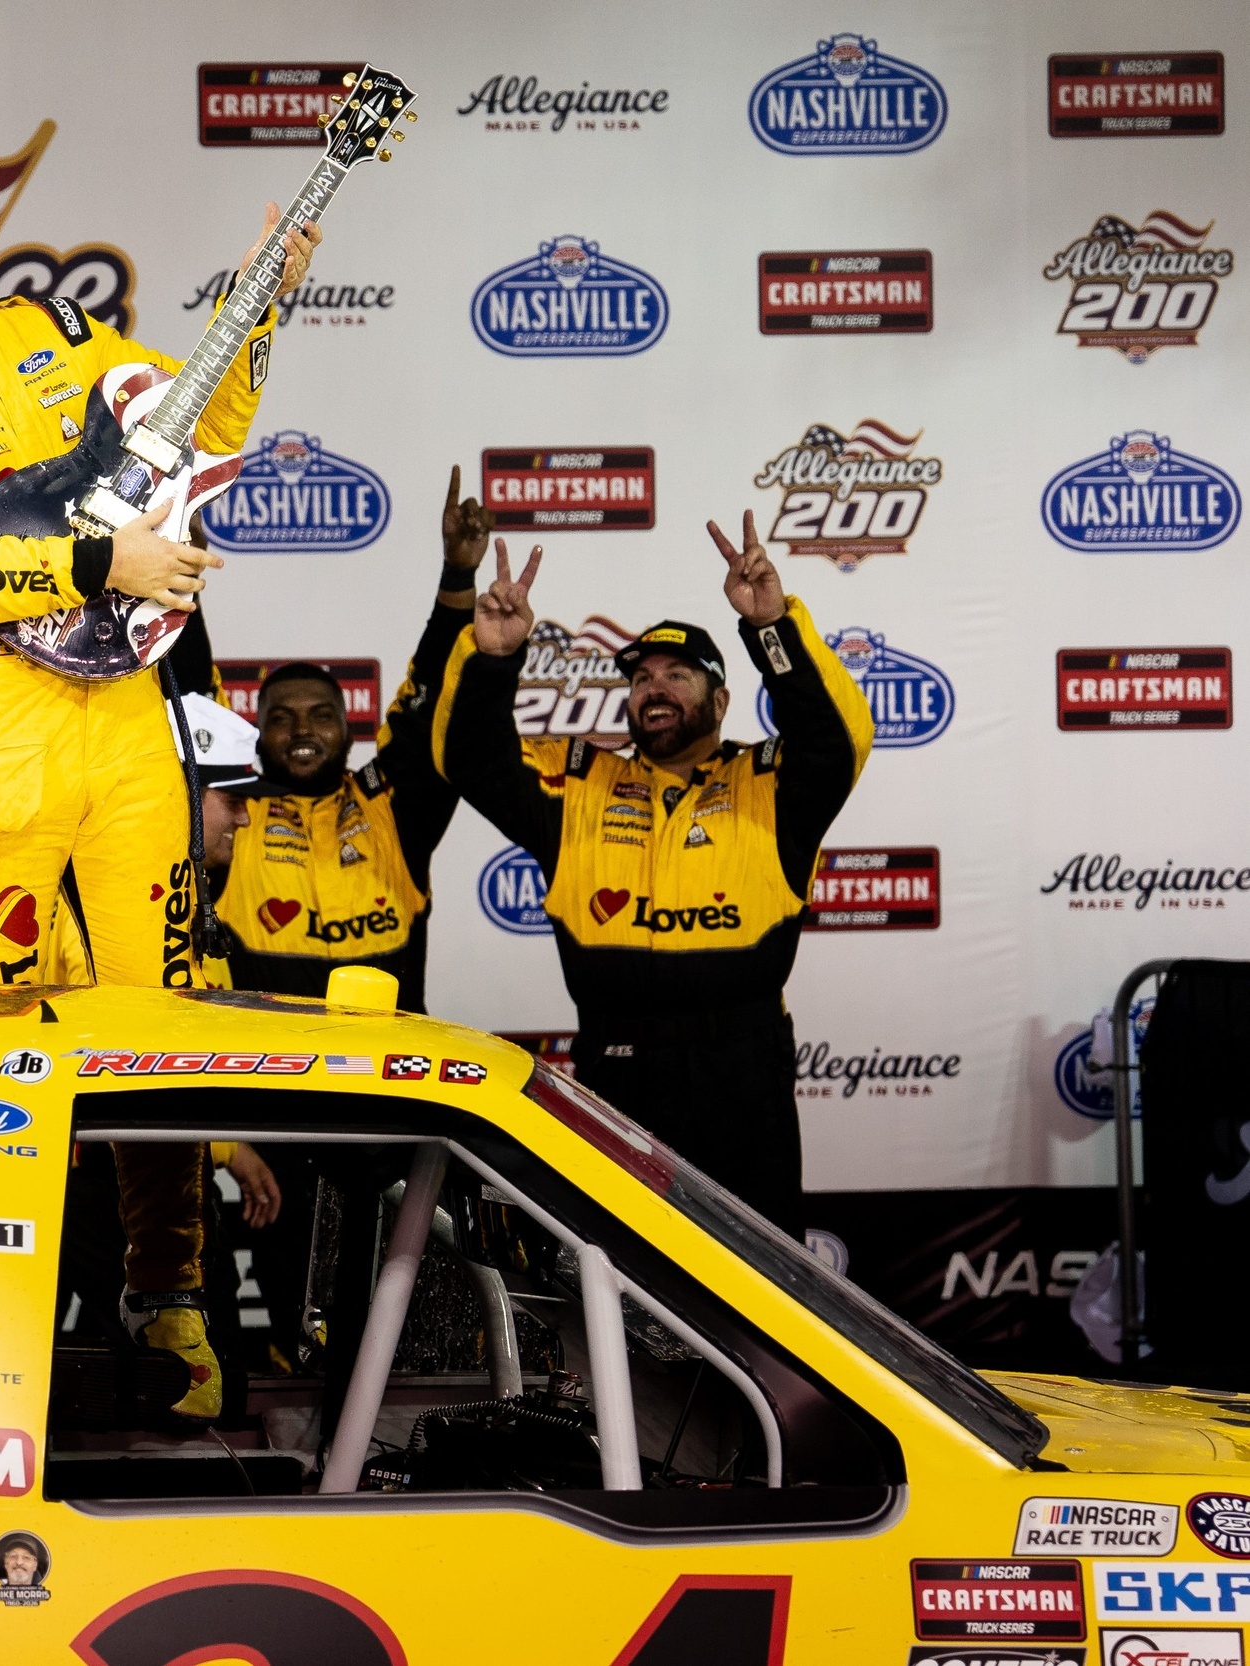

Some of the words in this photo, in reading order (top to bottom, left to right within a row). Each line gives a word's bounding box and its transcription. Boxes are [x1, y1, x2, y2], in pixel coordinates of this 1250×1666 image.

[207, 93, 351, 118] CRAFTSMA
[457, 74, 670, 131] Allegiance
[1057, 83, 1213, 107] CRAFTSMAN
[767, 87, 929, 130] NASHVILLE
[485, 120, 540, 132] MADE
[576, 120, 596, 131] IN
[603, 120, 641, 131] USA
[1047, 238, 1233, 291] Allegiance
[768, 281, 923, 304] CRAFTSMAN
[490, 289, 651, 331] NASHVILLE
[1061, 282, 1216, 332] 200
[301, 315, 323, 326] IN
[329, 315, 367, 326] USA
[23, 354, 49, 373] Ford
[24, 362, 67, 387] RACING
[38, 382, 83, 409] Rewards
[756, 445, 941, 498] Allegiance
[491, 477, 645, 500] CRAFTSMAN
[211, 485, 373, 526] NASHVILLE
[772, 490, 923, 540] 200
[1061, 485, 1223, 526] NASHVILLE
[1066, 676, 1221, 702] CRAFTSMAN
[1068, 899, 1124, 910] MADE
[1160, 898, 1180, 909] IN
[1188, 898, 1225, 909] USA
[76, 1052, 318, 1077] RIGGS
[793, 1042, 961, 1098] llegiance
[796, 1085, 833, 1098] ADE
[868, 1084, 888, 1097] IN
[896, 1084, 933, 1096] USA
[1069, 1505, 1157, 1527] NASCAR
[1196, 1497, 1250, 1516] NASC
[1026, 1529, 1083, 1547] RACE
[1089, 1530, 1162, 1547] TRUCK
[1204, 1528, 1250, 1553] SALU
[978, 1565, 1031, 1580] NASCAR
[16, 1590, 50, 1599] MORRIS
[922, 1588, 1075, 1612] CRAFTSMAN
[966, 1621, 999, 1635] TRUCK
[999, 1621, 1035, 1635] SERIES
